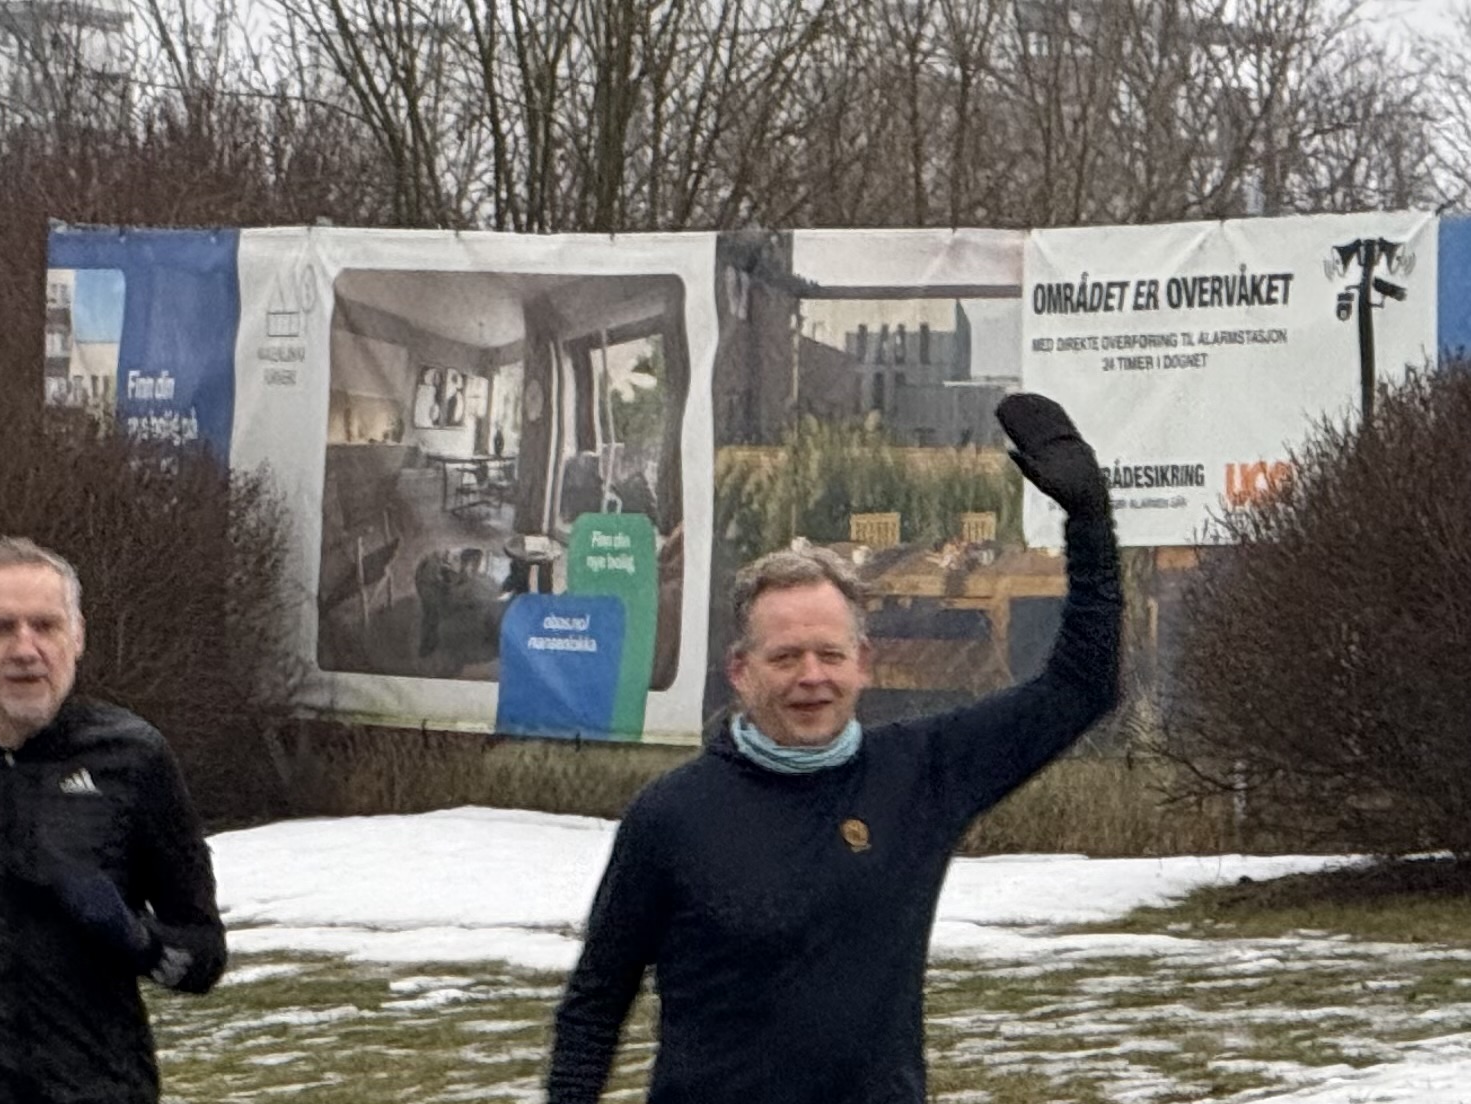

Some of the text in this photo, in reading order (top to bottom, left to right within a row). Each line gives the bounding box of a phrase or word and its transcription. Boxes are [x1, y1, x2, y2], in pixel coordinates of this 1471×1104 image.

[1033, 263, 1295, 315] OMRÅDET ER OVERVÅKET
[1032, 337, 1054, 352] MED
[1056, 335, 1099, 351] DIREKTE
[1116, 355, 1154, 371] TIMER
[1101, 458, 1206, 489] RÅDESIKRING
